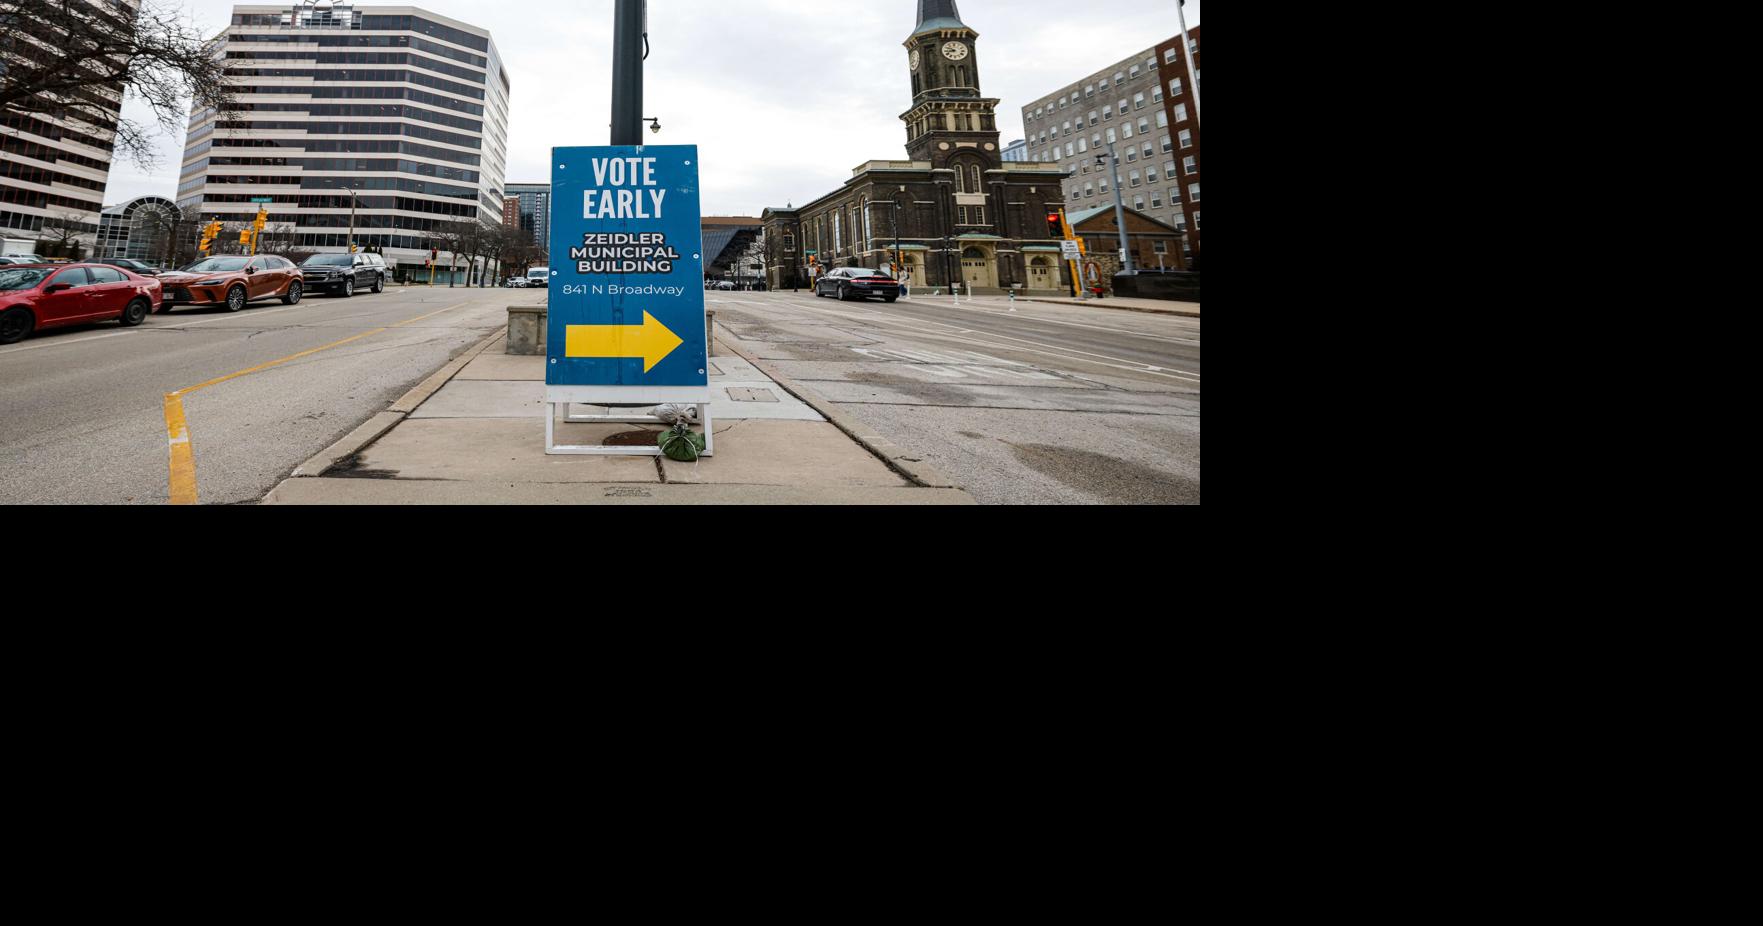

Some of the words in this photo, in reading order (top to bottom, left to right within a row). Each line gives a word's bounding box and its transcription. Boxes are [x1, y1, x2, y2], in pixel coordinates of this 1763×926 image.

[591, 157, 657, 187] VOTE
[583, 188, 666, 219] EARLY
[584, 233, 664, 245] ZEIDLER
[571, 246, 679, 259] MUNICIPAL
[578, 260, 671, 272] BUILDING
[562, 284, 587, 295] 841
[592, 284, 603, 295] N
[608, 284, 684, 297] Broadway
